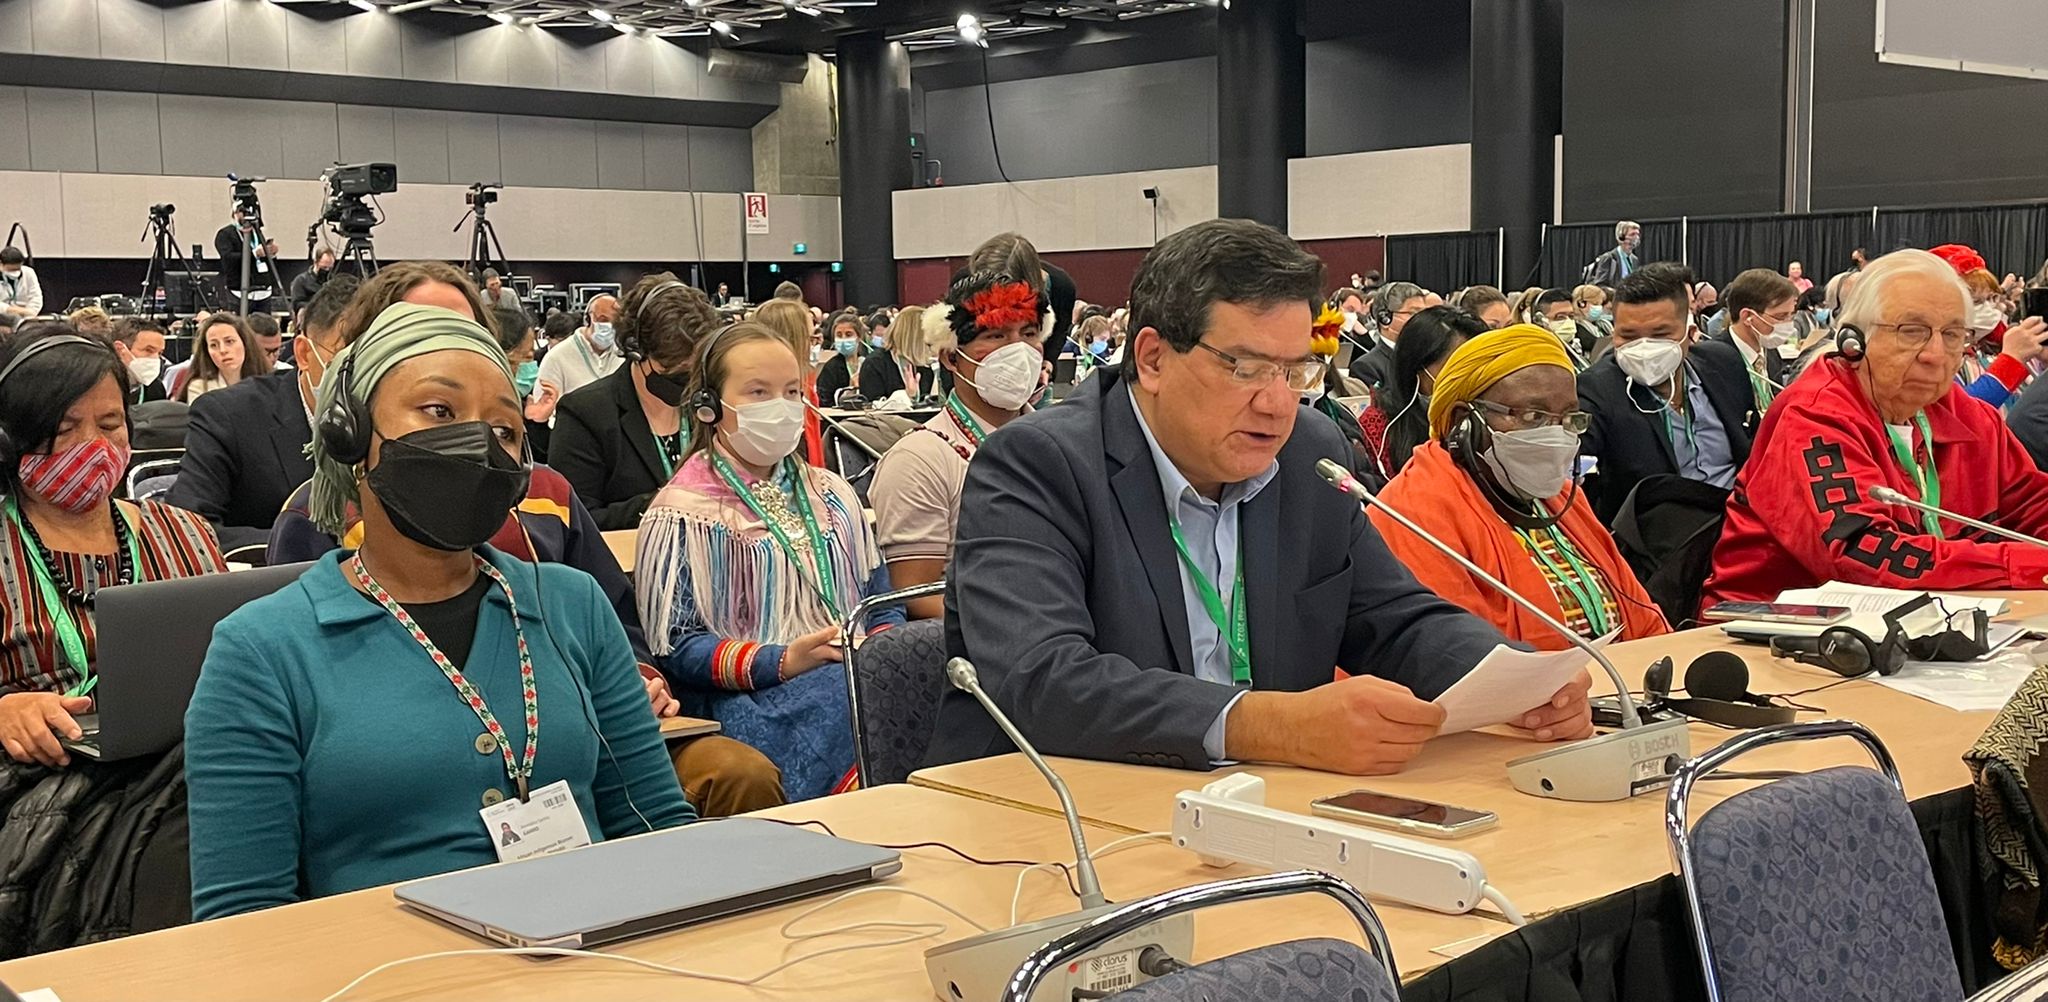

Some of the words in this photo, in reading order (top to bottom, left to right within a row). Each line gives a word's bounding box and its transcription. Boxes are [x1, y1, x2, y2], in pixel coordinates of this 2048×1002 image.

[1237, 622, 1246, 642] 2022
[1644, 732, 1679, 755] BOSCH
[1103, 953, 1128, 967] clarus
